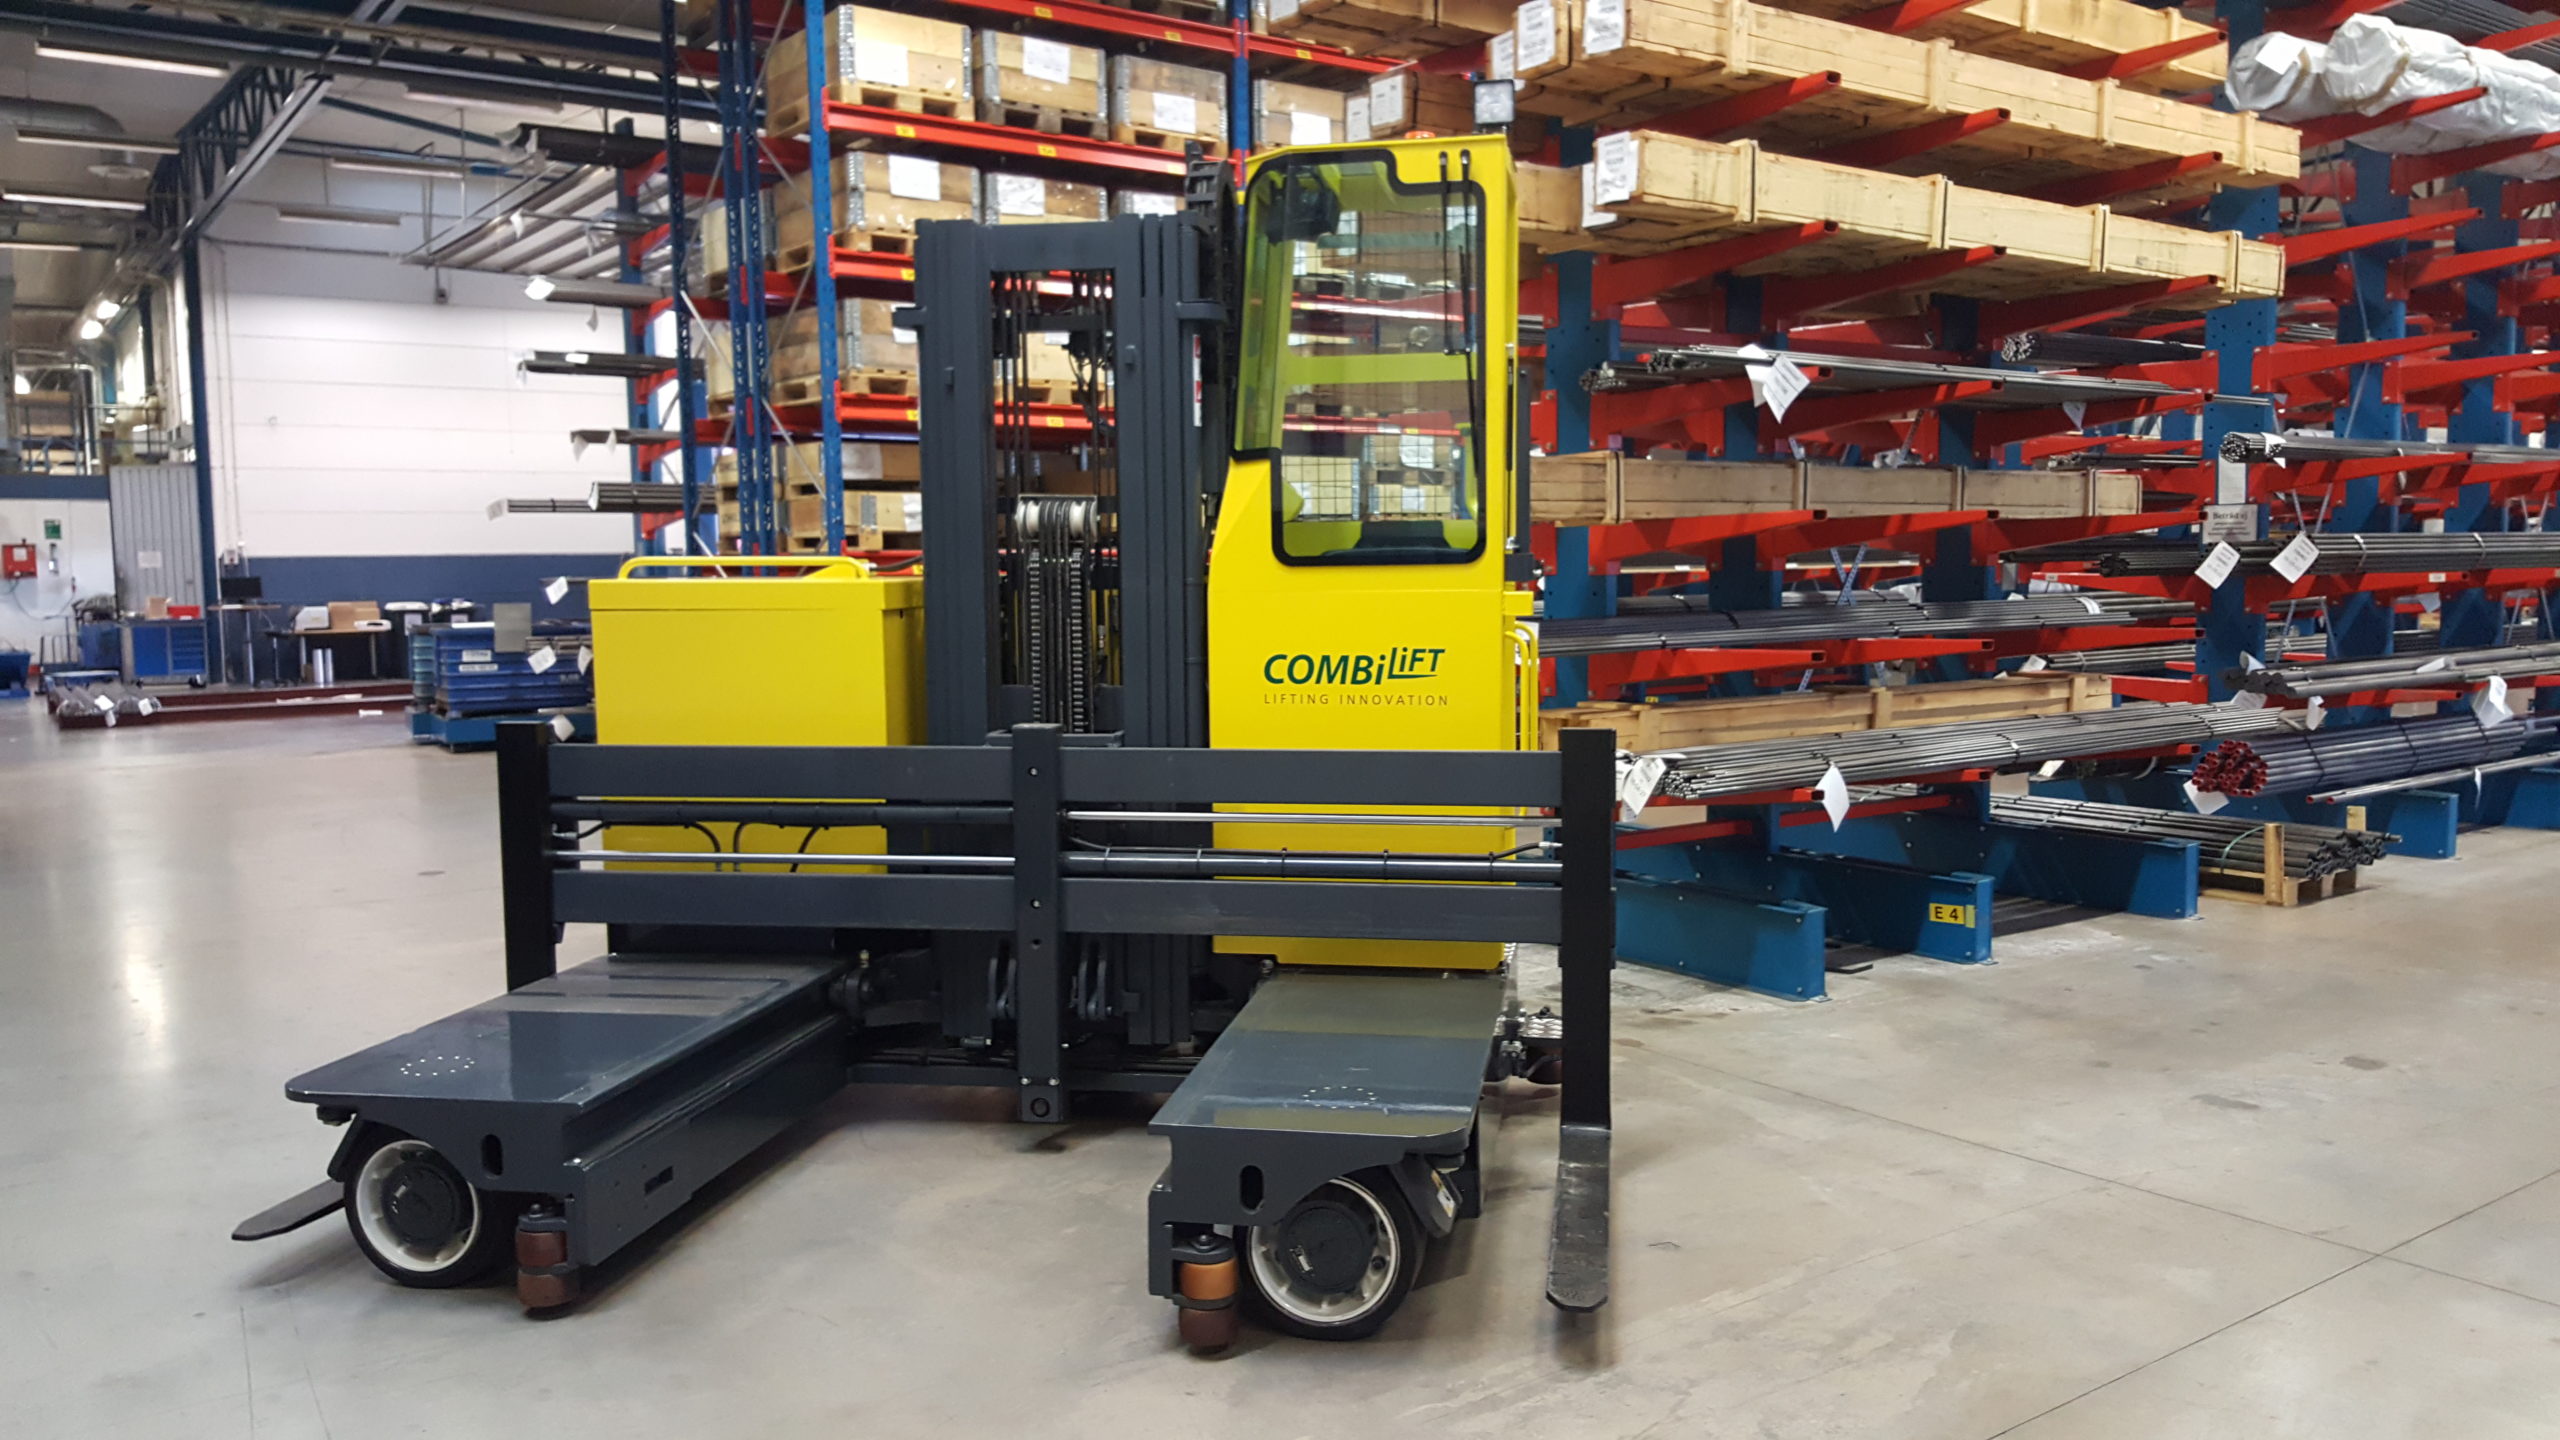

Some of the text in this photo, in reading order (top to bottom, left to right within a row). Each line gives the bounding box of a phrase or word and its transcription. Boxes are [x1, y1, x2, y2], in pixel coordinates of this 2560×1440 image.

[1264, 693, 1448, 707] LIFTING INNOVATION
[1934, 905, 1959, 921] E 4
